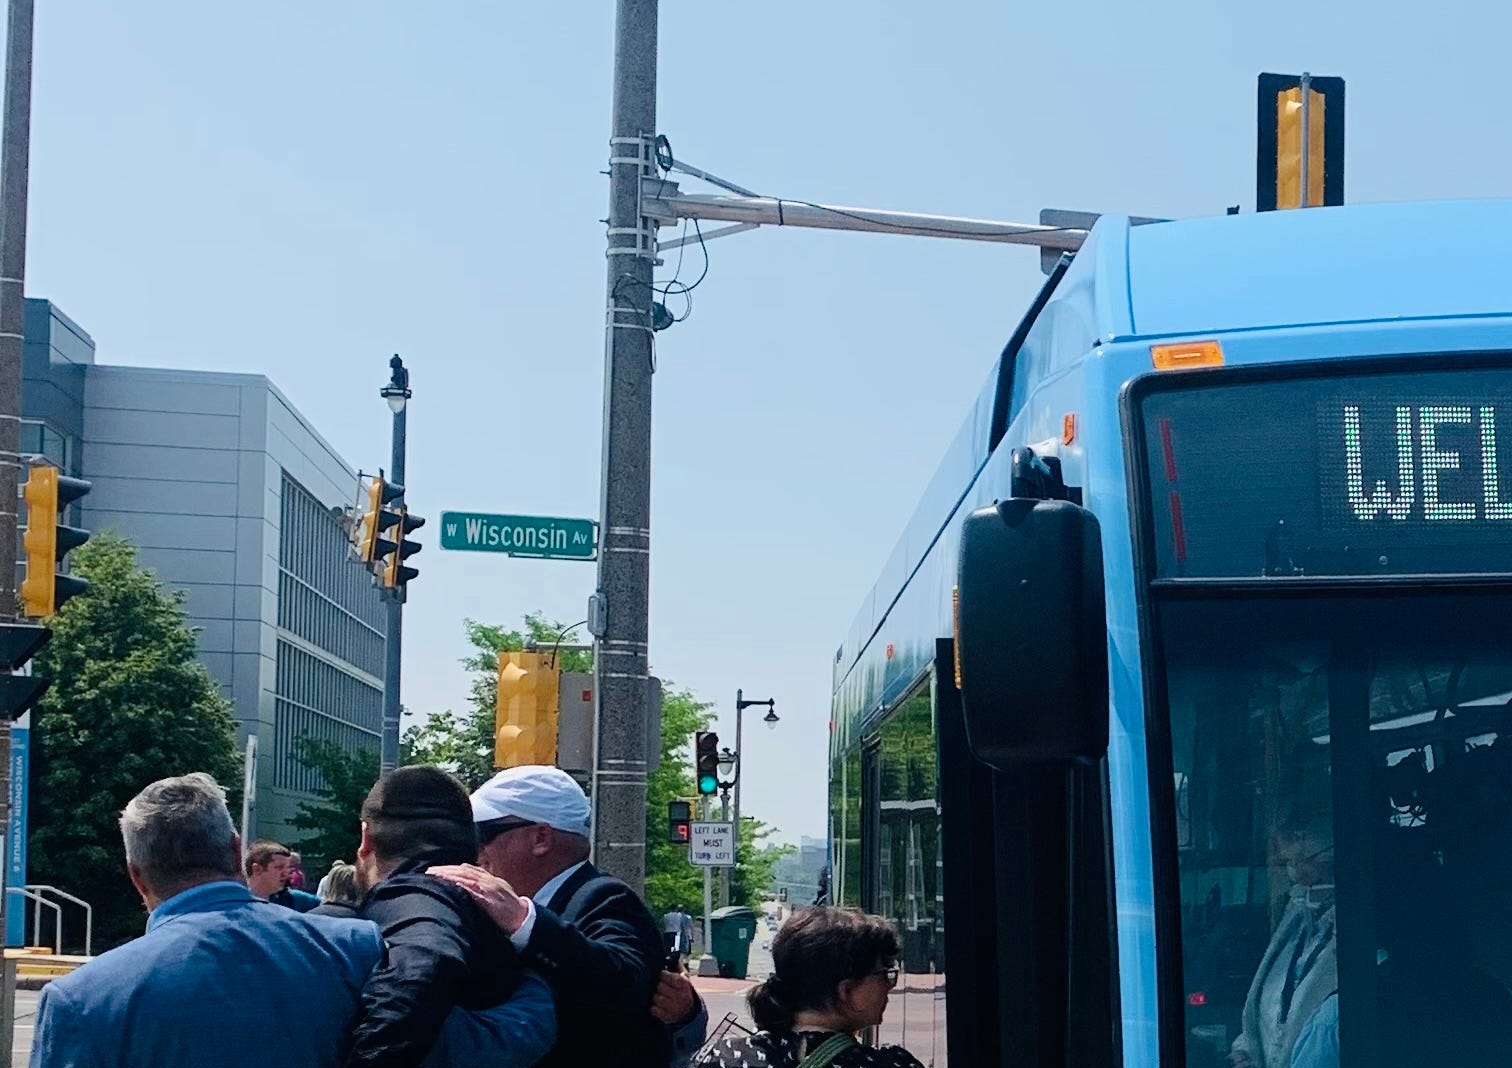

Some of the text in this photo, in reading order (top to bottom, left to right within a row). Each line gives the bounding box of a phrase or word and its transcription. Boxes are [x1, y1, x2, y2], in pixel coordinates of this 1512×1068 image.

[446, 517, 587, 549] W Wisconsin Av
[695, 827, 728, 835] LEFT LANE
[703, 839, 723, 847] MUST
[715, 852, 730, 860] LEFT
